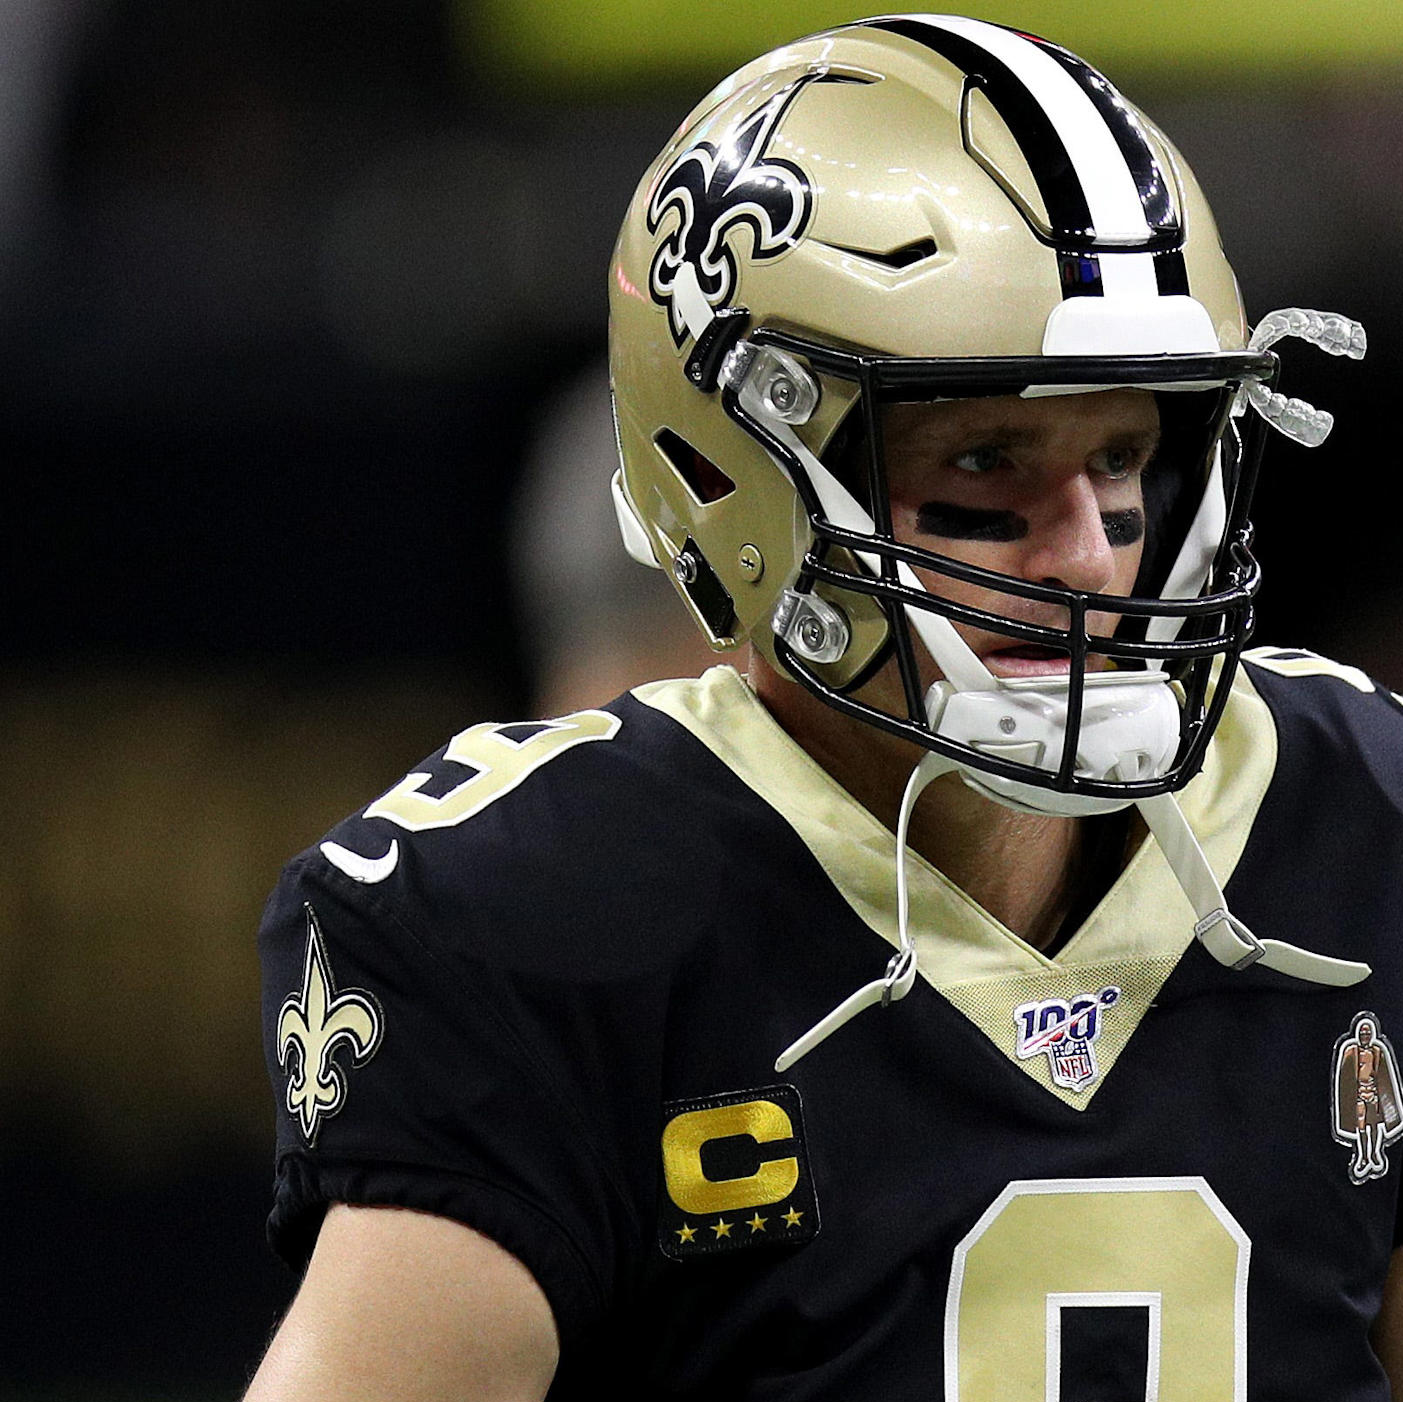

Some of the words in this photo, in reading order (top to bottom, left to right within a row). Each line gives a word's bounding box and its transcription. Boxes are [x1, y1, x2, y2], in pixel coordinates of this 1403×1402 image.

[362, 709, 622, 832] 9
[1021, 1000, 1098, 1048] 100
[1058, 1056, 1090, 1079] NFL
[661, 1099, 799, 1215] C
